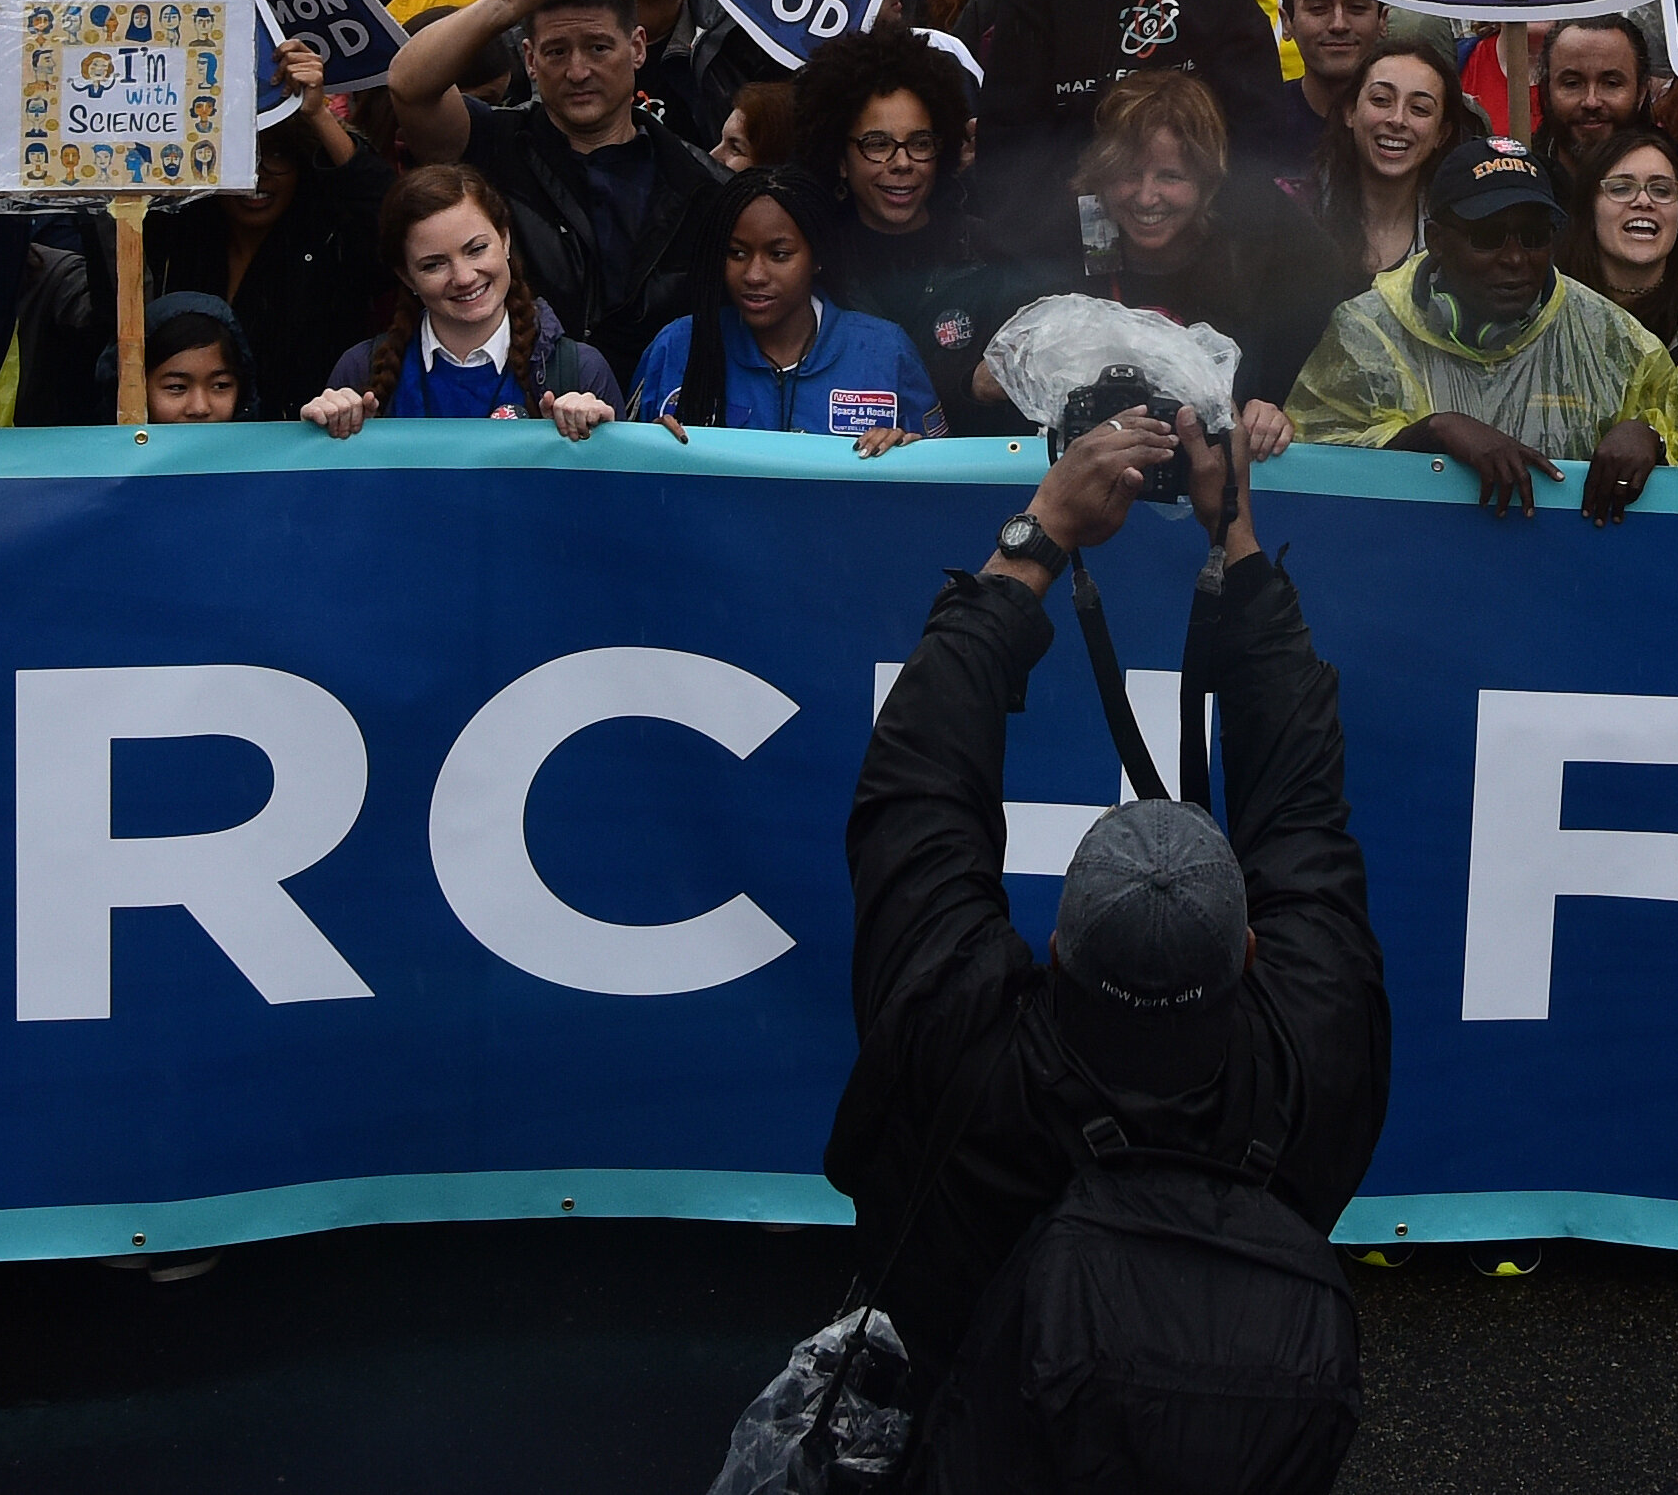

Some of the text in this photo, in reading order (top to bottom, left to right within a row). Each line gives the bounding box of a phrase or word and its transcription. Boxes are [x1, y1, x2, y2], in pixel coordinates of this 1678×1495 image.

[119, 47, 167, 84] I'm
[126, 84, 177, 105] with
[68, 107, 178, 134] SCIENCE
[1473, 158, 1539, 180] EMORY
[834, 393, 861, 403] NASA
